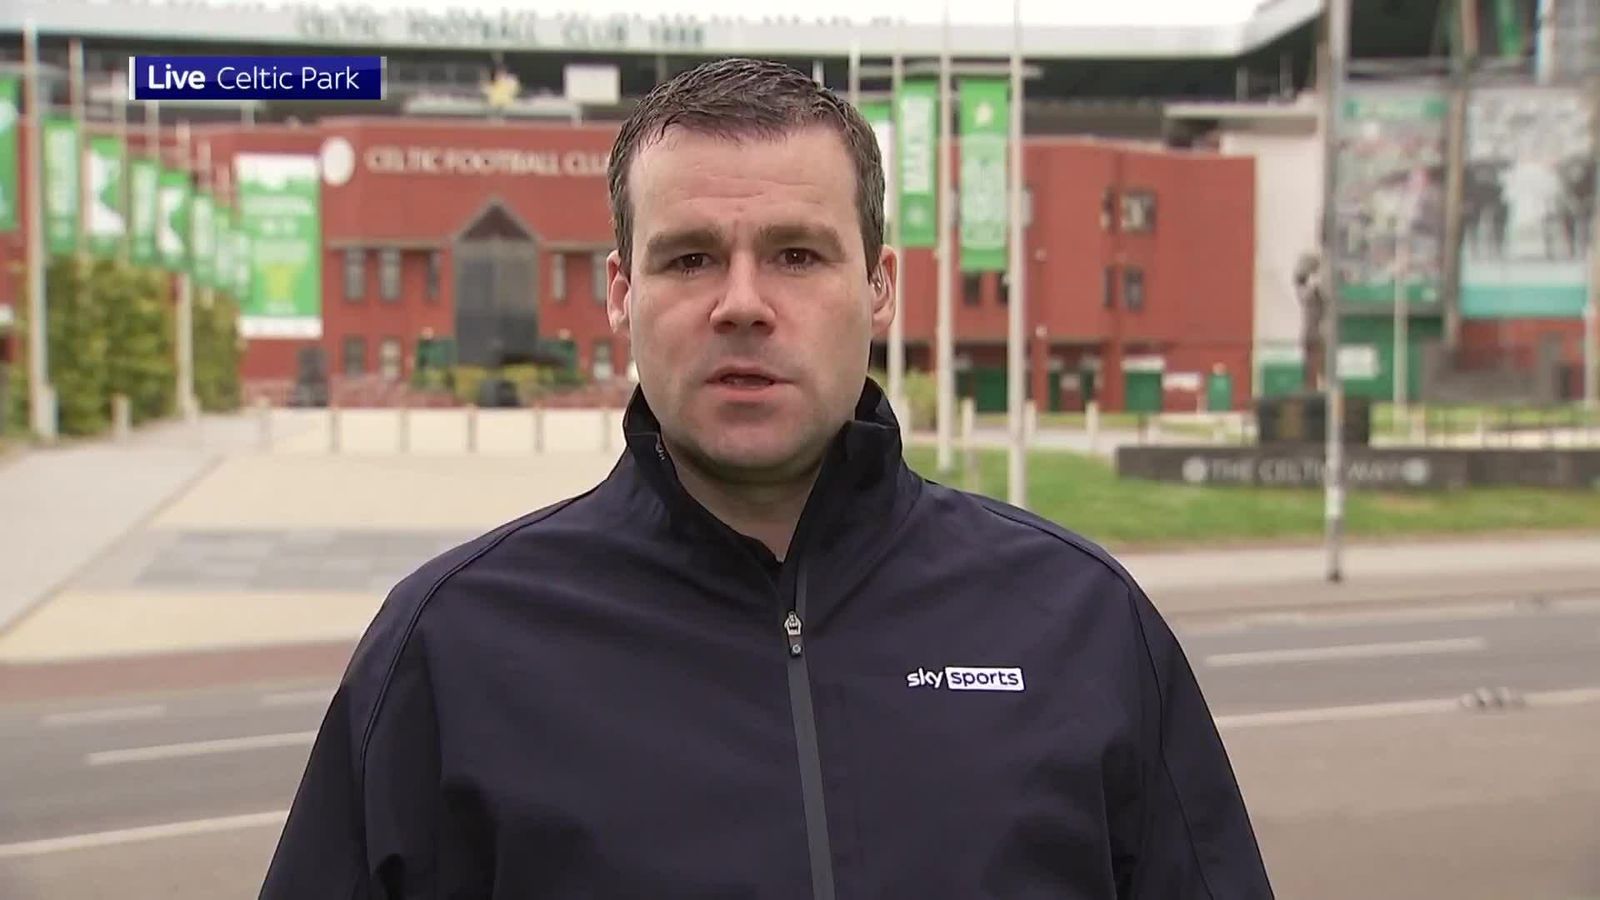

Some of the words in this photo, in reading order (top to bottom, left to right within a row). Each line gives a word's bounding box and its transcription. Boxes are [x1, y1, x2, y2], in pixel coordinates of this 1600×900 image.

[446, 148, 560, 176] FOOTBALL
[561, 150, 611, 177] CLU
[1259, 457, 1326, 485] CELTI
[906, 667, 944, 689] sky
[950, 671, 1020, 687] sports
